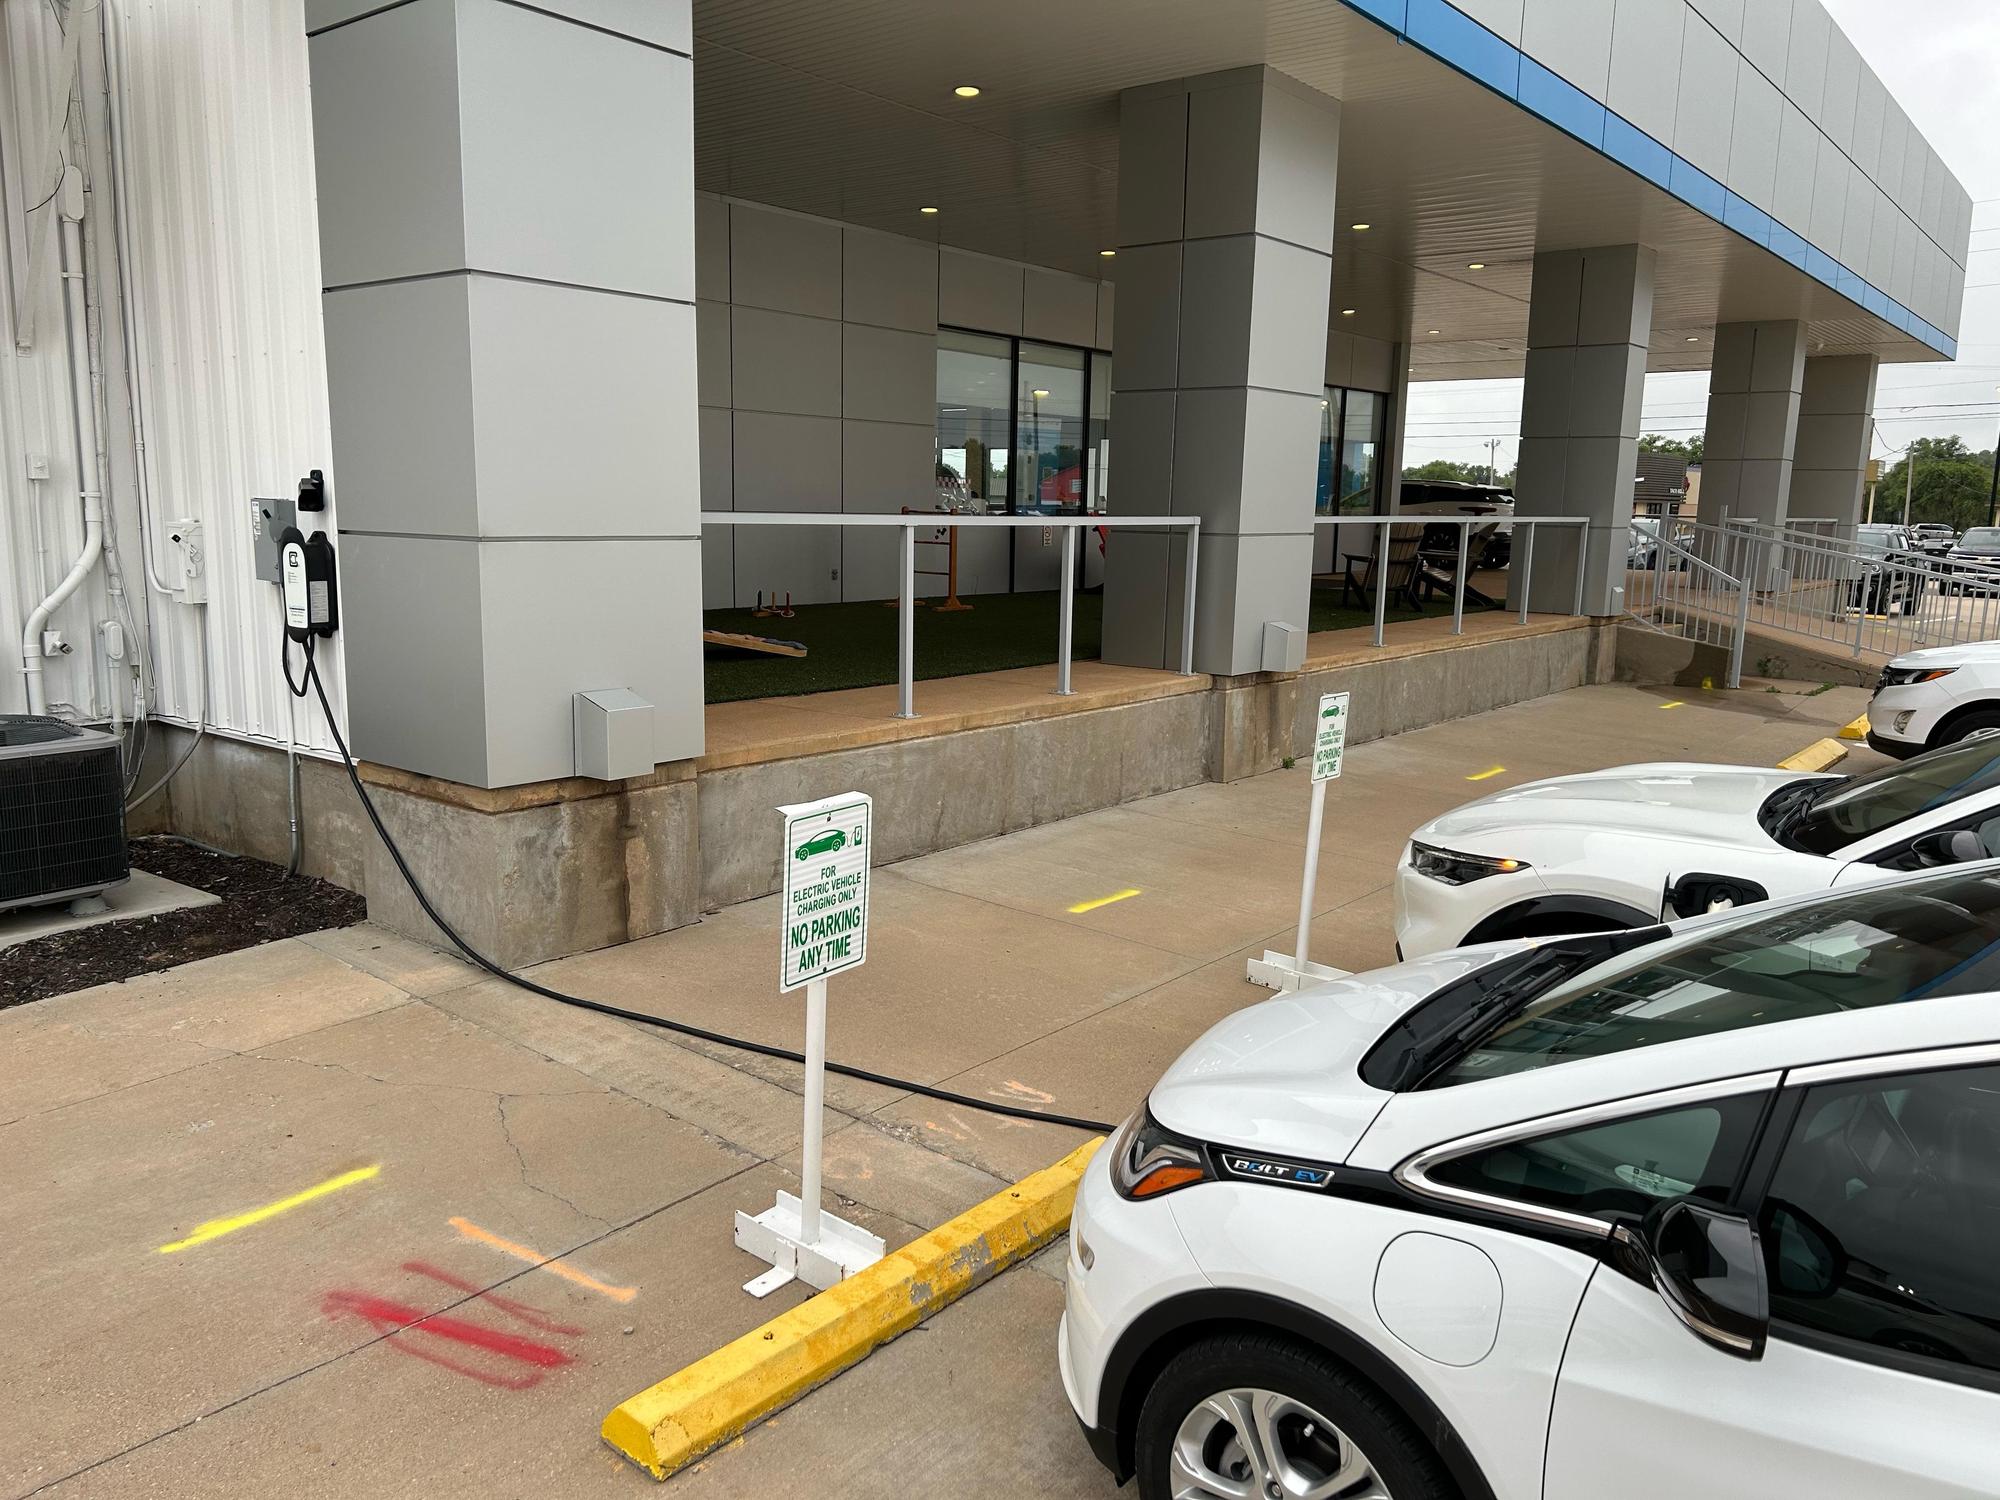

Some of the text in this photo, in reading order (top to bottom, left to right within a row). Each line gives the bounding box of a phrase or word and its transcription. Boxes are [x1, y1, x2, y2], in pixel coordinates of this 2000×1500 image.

[1323, 746, 1341, 760] PARKING
[1317, 760, 1337, 775] ANY TIME
[821, 865, 836, 880] FOR
[793, 872, 861, 903] ELECTRIC VEHICLE
[797, 887, 857, 916] CHARGING ONLY
[791, 906, 860, 949] NO PARKING
[798, 934, 851, 973] ANY TIME
[1233, 1159, 1324, 1182] BOLT EV
